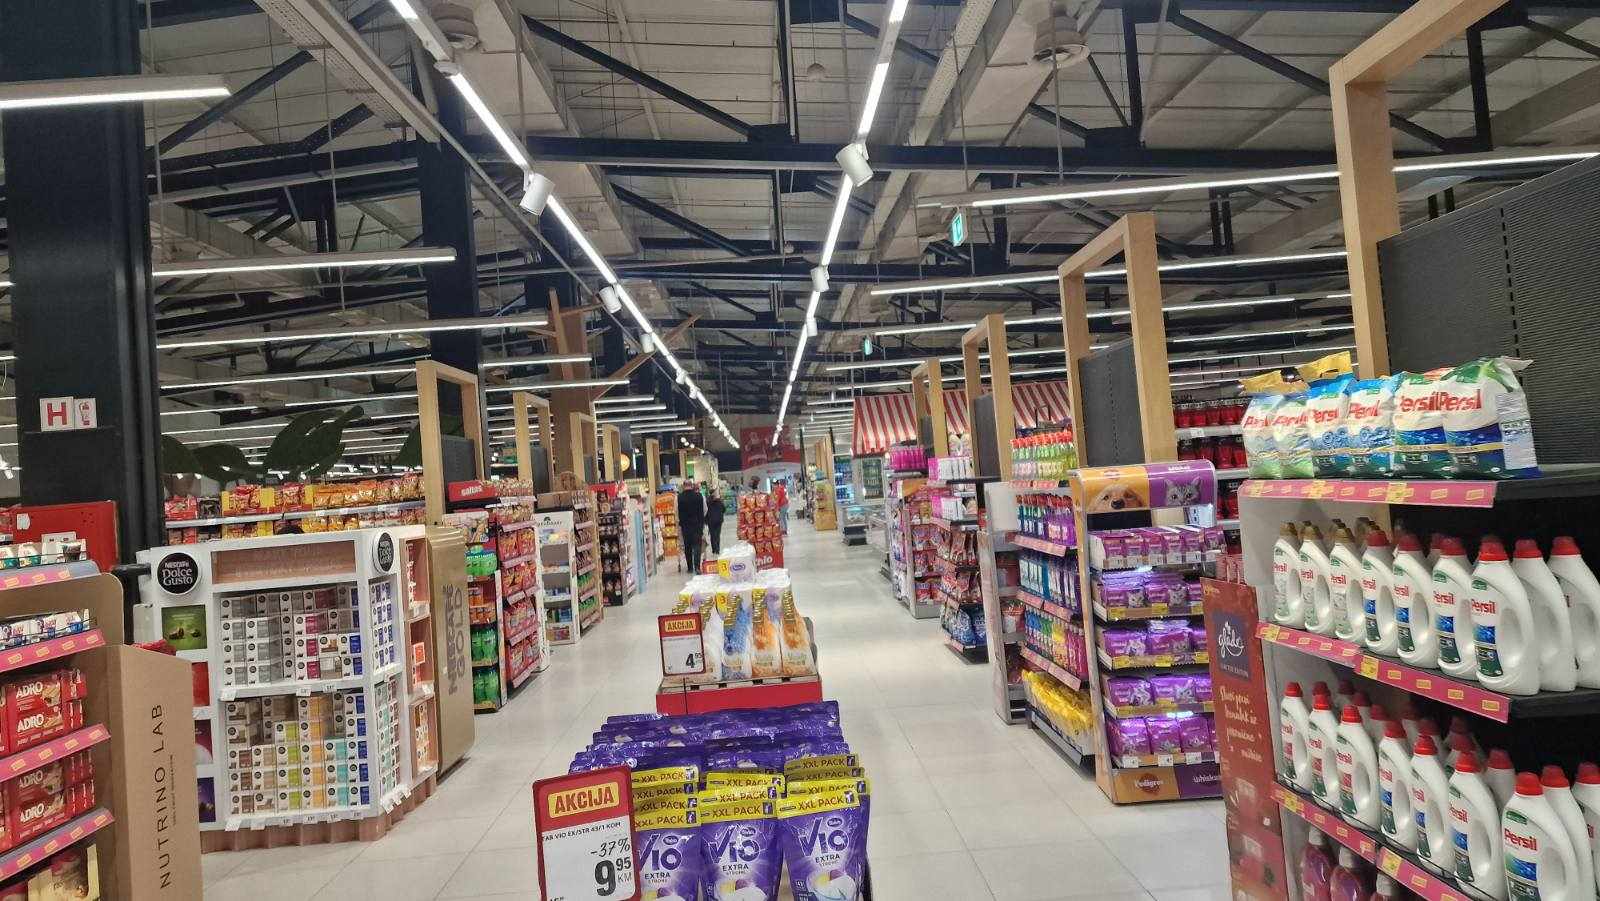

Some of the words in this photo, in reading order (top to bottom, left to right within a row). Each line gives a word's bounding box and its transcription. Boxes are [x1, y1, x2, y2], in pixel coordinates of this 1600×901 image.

[47, 402, 67, 426] H
[162, 568, 193, 579] Dolce
[163, 576, 193, 586] Gusto
[667, 620, 693, 631] AKCIJA
[686, 653, 695, 668] 4
[152, 704, 165, 753] LAB
[821, 758, 845, 767] PACK
[661, 771, 684, 781] PACK
[657, 787, 683, 797] PACK
[740, 791, 767, 801] PACK
[554, 786, 614, 814] AKCIJA
[660, 800, 687, 810] PACK
[818, 795, 844, 807] PACK
[734, 805, 761, 815] PACK
[657, 815, 684, 825] PACK
[154, 766, 172, 889] NUTRINO
[554, 831, 566, 840] VIO
[1504, 827, 1537, 851] Persil
[590, 838, 630, 858] -37%
[815, 853, 840, 864] EXTRA
[594, 860, 617, 897] 9
[616, 857, 631, 871] 95
[617, 872, 632, 884] KM
[644, 872, 671, 880] EXTRA
